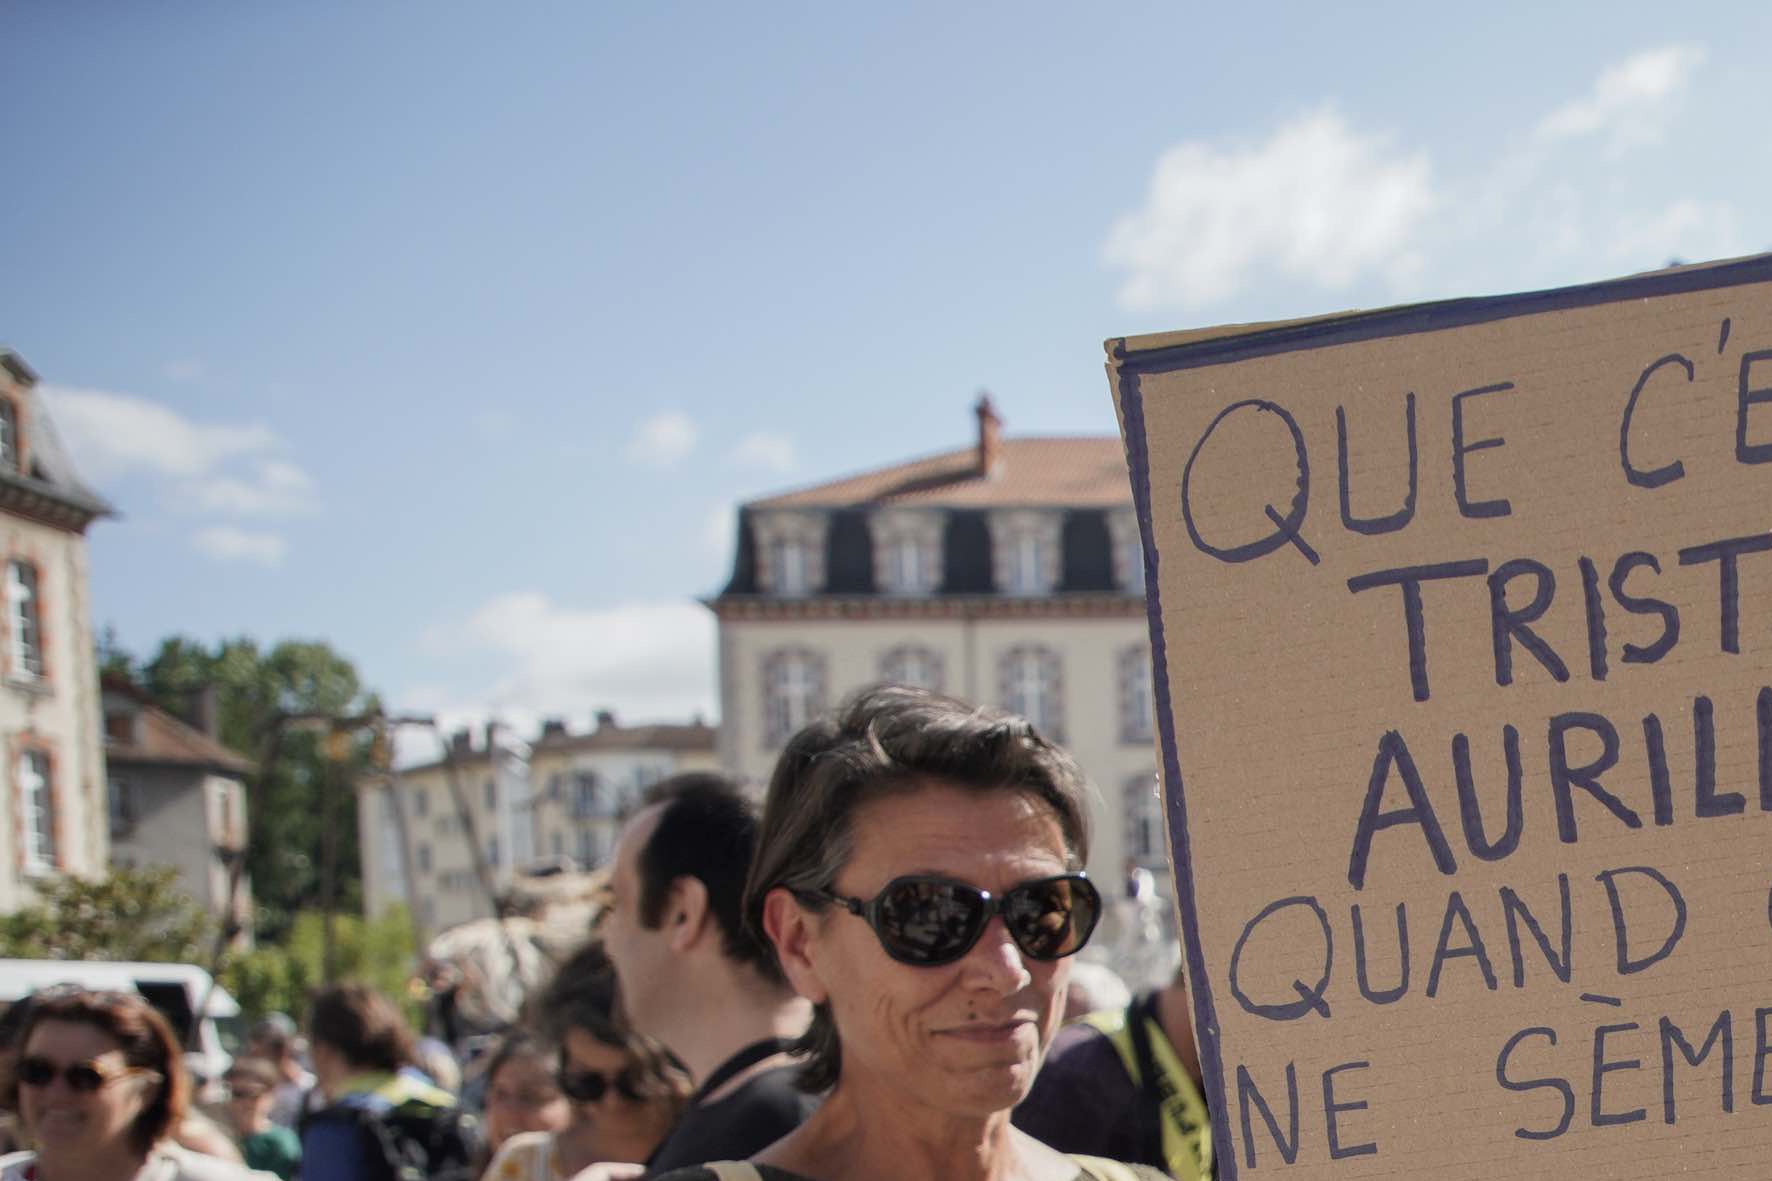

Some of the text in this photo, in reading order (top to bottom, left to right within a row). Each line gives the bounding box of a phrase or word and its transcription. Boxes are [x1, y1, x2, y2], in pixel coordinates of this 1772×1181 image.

[1180, 381, 1514, 566] QUE
[1228, 867, 1687, 1021] QUAND
[1236, 1060, 1377, 1169] NE
